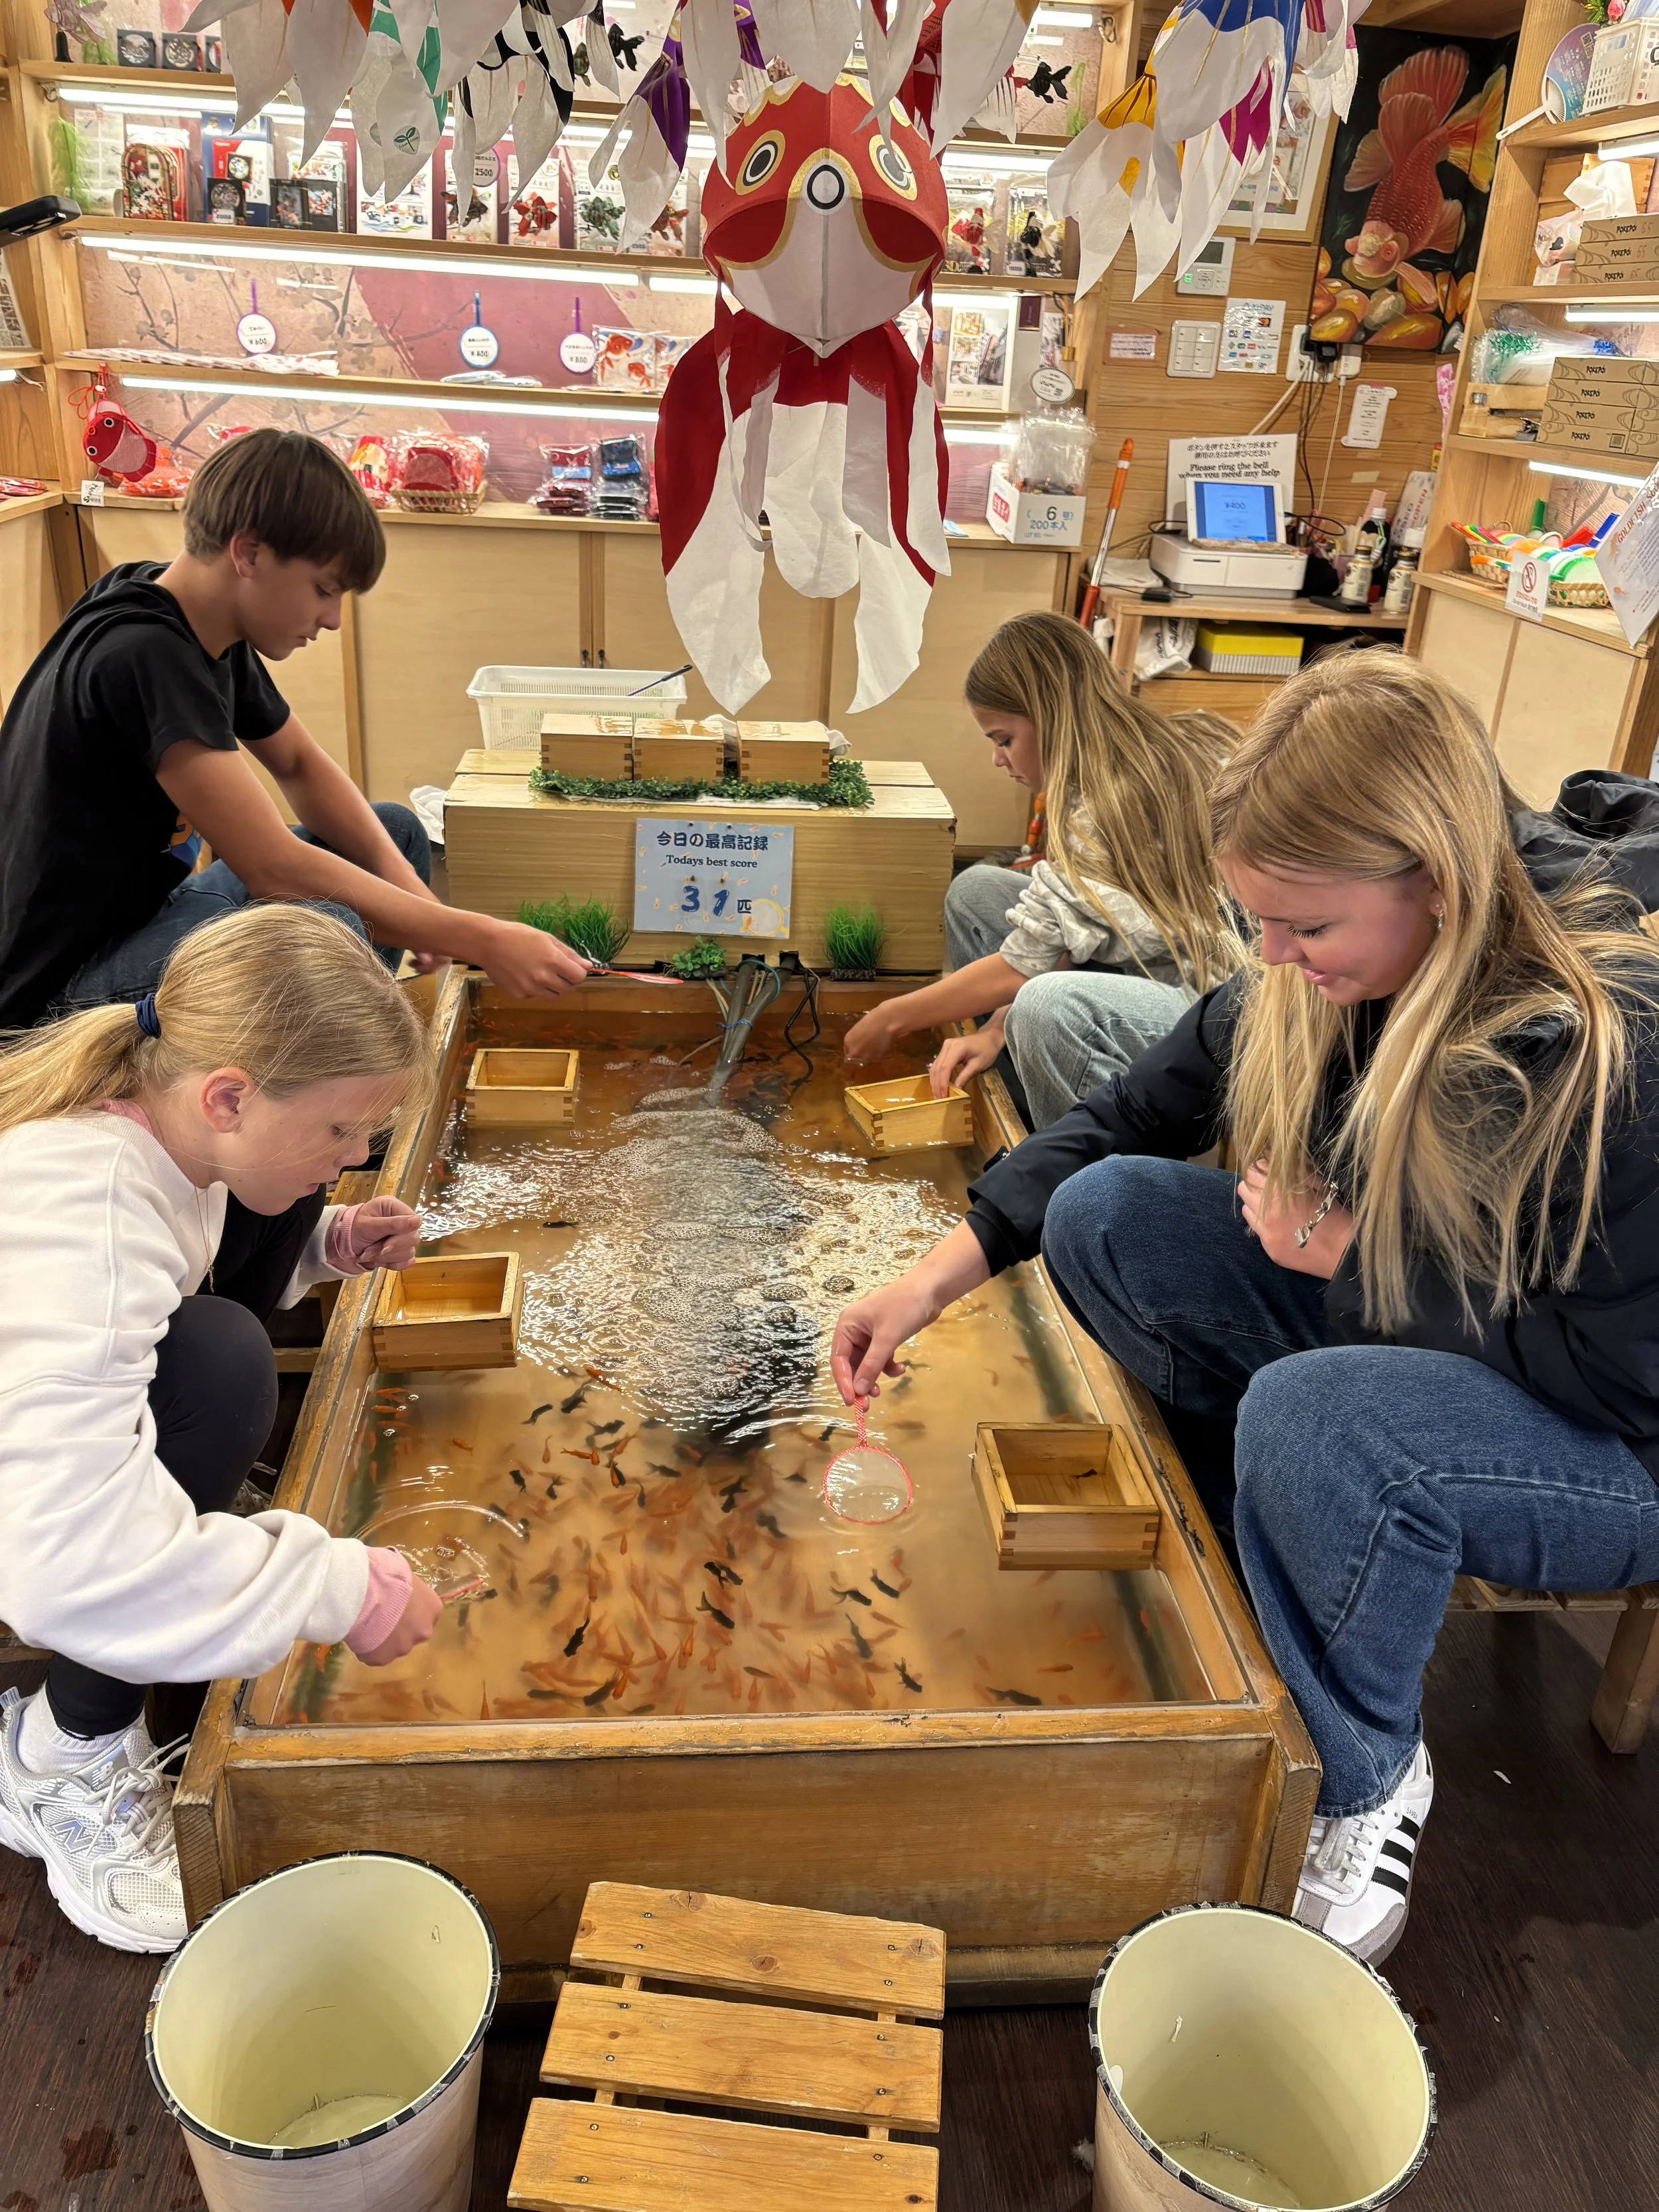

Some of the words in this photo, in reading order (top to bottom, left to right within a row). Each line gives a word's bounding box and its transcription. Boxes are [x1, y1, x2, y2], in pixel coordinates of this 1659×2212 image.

[1218, 463, 1236, 471] ring
[1261, 469, 1280, 478] help
[1046, 506, 1058, 521] 6
[1030, 520, 1068, 531] 200本入
[1617, 501, 1646, 544] GOLDFISH
[656, 831, 768, 851] 今日の最高記録
[666, 855, 703, 867] Todays
[706, 857, 728, 867] best
[1406, 1806, 1417, 1818] SAMBA
